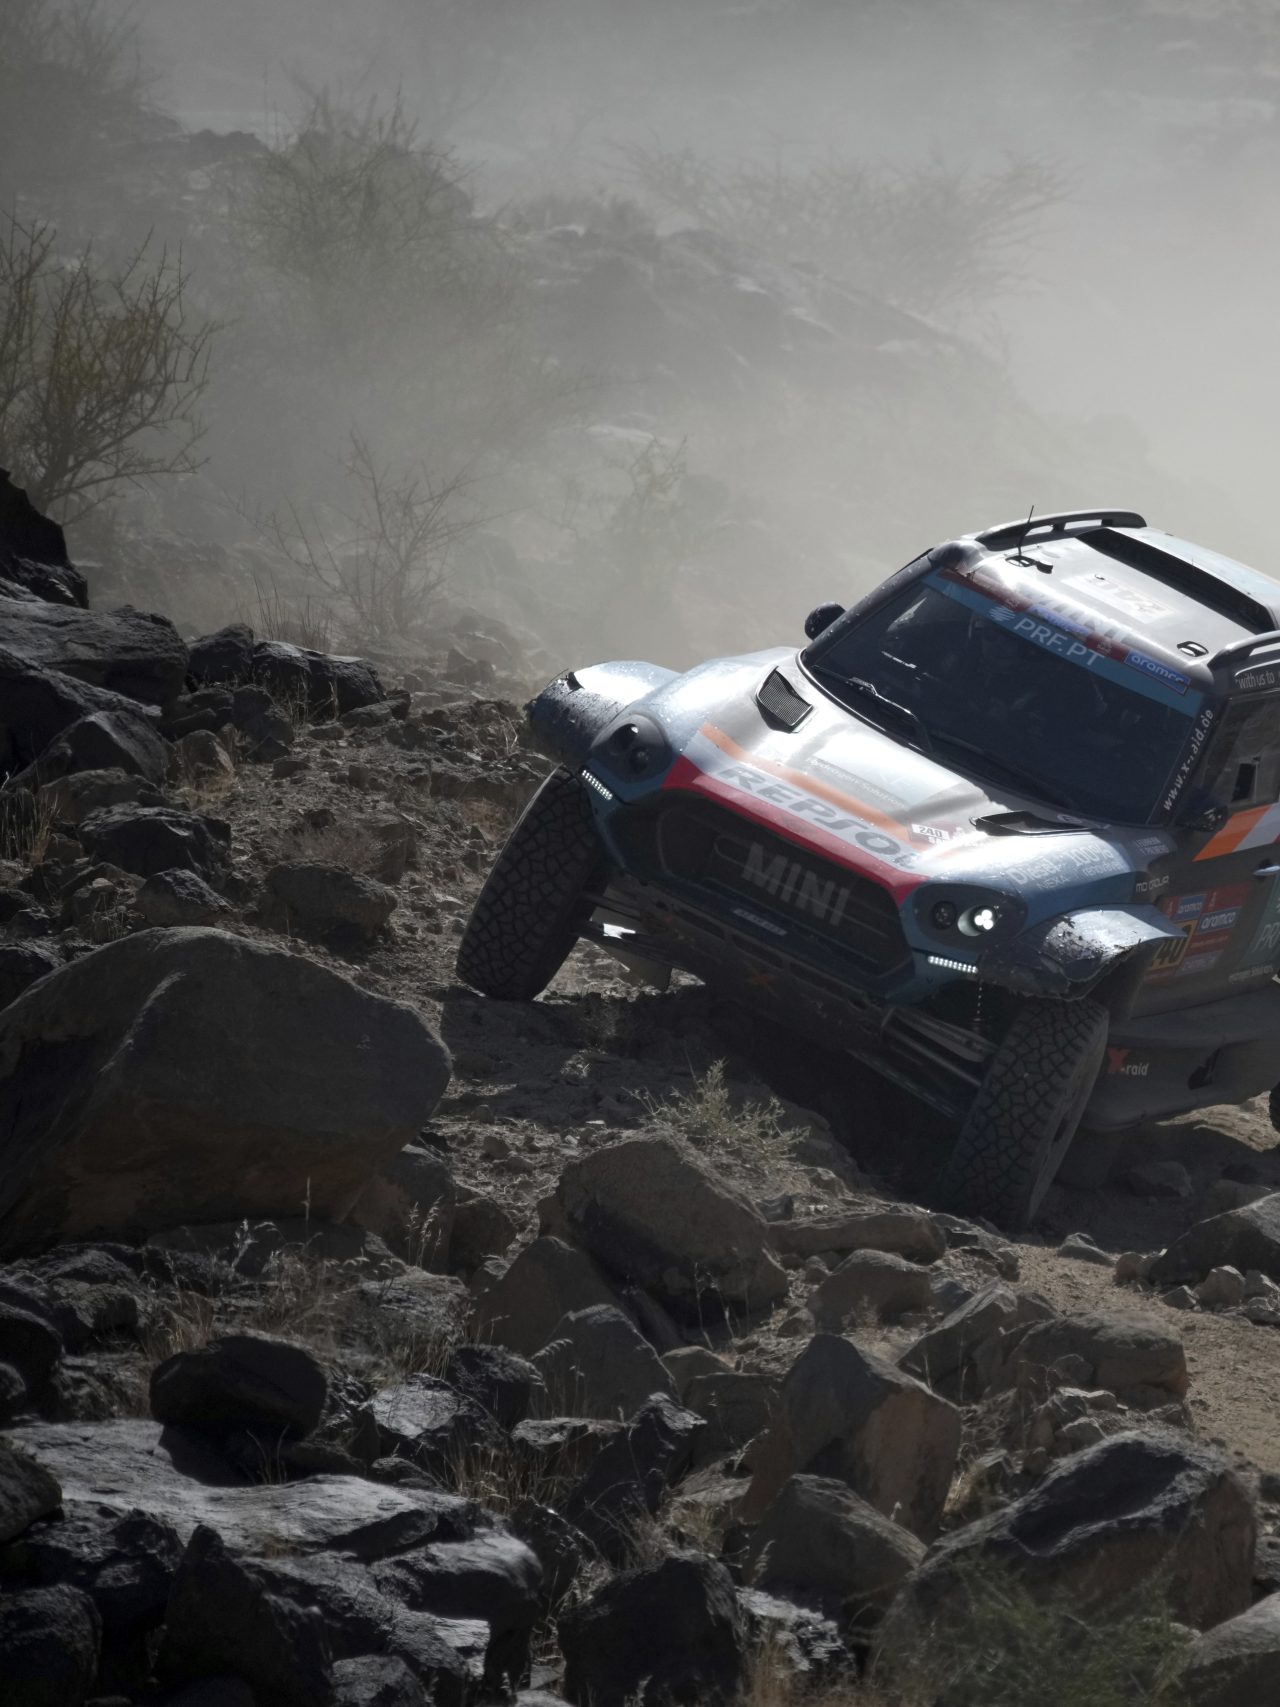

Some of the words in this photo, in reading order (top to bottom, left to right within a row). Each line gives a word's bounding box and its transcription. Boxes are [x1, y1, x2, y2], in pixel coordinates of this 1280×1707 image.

[1013, 614, 1106, 668] PRF.PT
[718, 765, 918, 870] REPSOL
[741, 841, 851, 927] MINI
[1201, 911, 1237, 930] aramco
